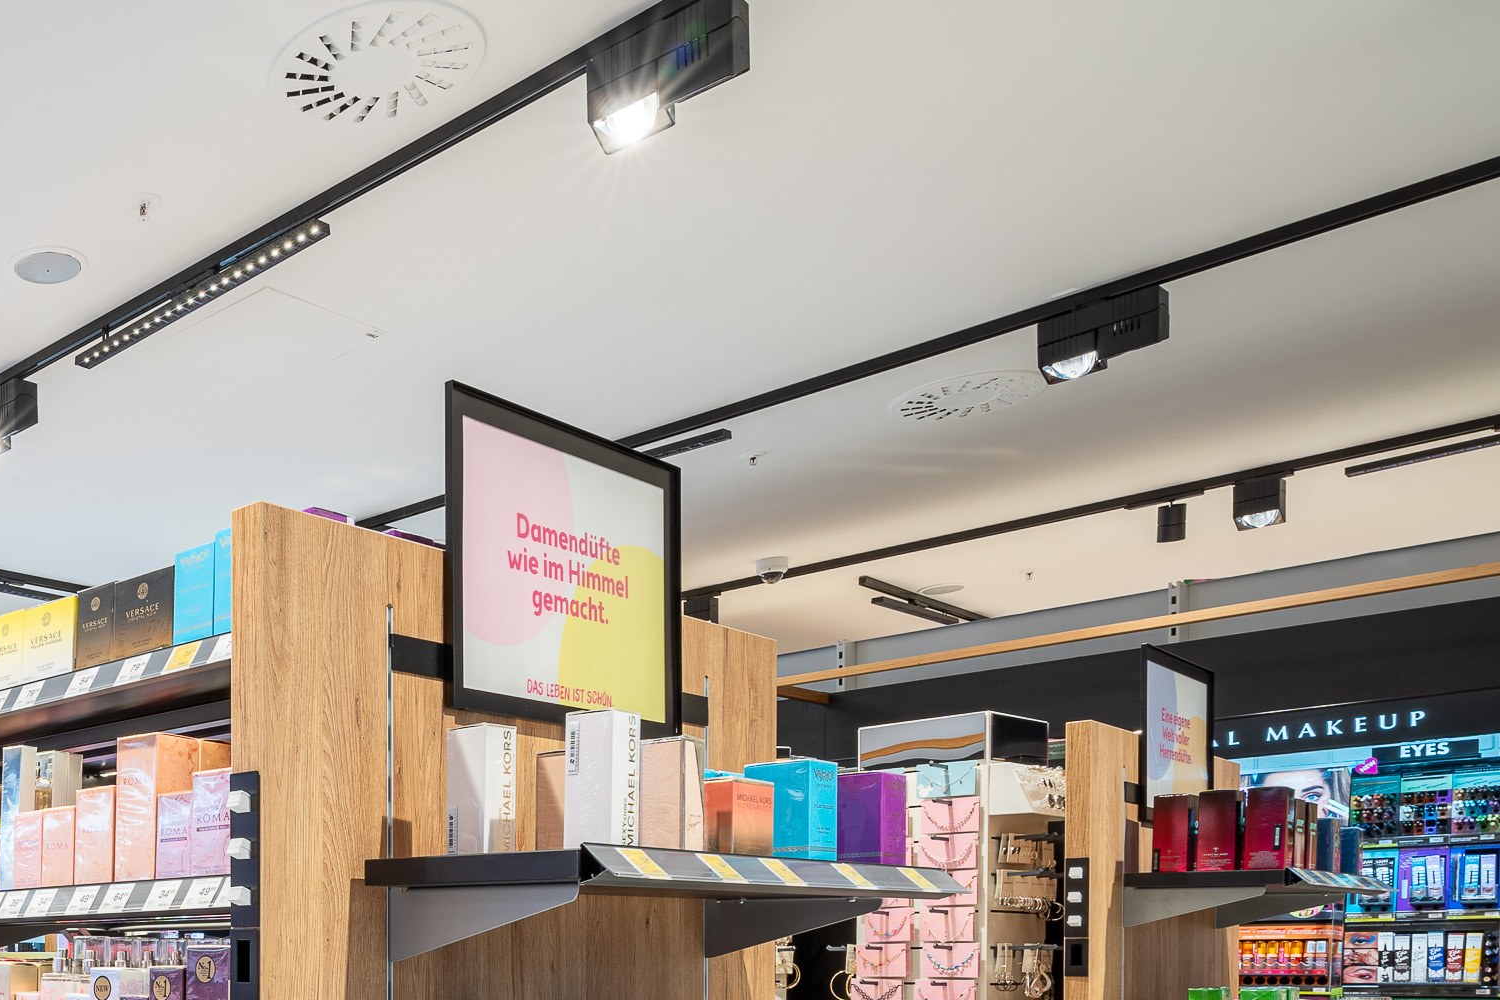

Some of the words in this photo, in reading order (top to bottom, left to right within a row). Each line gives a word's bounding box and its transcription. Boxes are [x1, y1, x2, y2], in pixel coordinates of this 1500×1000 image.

[516, 512, 621, 566] Damendüfte
[507, 549, 539, 575] wie
[543, 553, 564, 582] im
[568, 558, 630, 599] Himmel
[125, 603, 160, 619] VERSACE
[532, 589, 609, 625] gemacht.
[82, 617, 108, 630] VERSACE
[30, 630, 62, 645] VERSACE
[527, 678, 544, 695] DAS
[546, 683, 570, 702] LEBEN
[573, 688, 584, 704] IST
[586, 688, 614, 708] SCHÖN.
[1162, 707, 1173, 724] Eine
[1174, 712, 1190, 730] eigene
[1266, 710, 1426, 742] MAKEUP
[628, 715, 637, 762] KORS
[1162, 726, 1174, 742] Welt
[1176, 731, 1190, 746] voller
[503, 730, 511, 775] KORS
[1160, 743, 1192, 764] Herrendüfte.
[1400, 742, 1450, 758] EYES
[1358, 759, 1377, 773] NEW
[123, 776, 148, 786] ROMA
[627, 770, 636, 846] MICHAEL
[737, 793, 758, 802] MICHAEL
[759, 797, 772, 805] KORS
[196, 812, 230, 824] ROMA
[501, 780, 511, 852] MICHAEL
[160, 827, 187, 837] ROMA
[46, 842, 68, 850] ROMA
[95, 984, 110, 992] NEW
